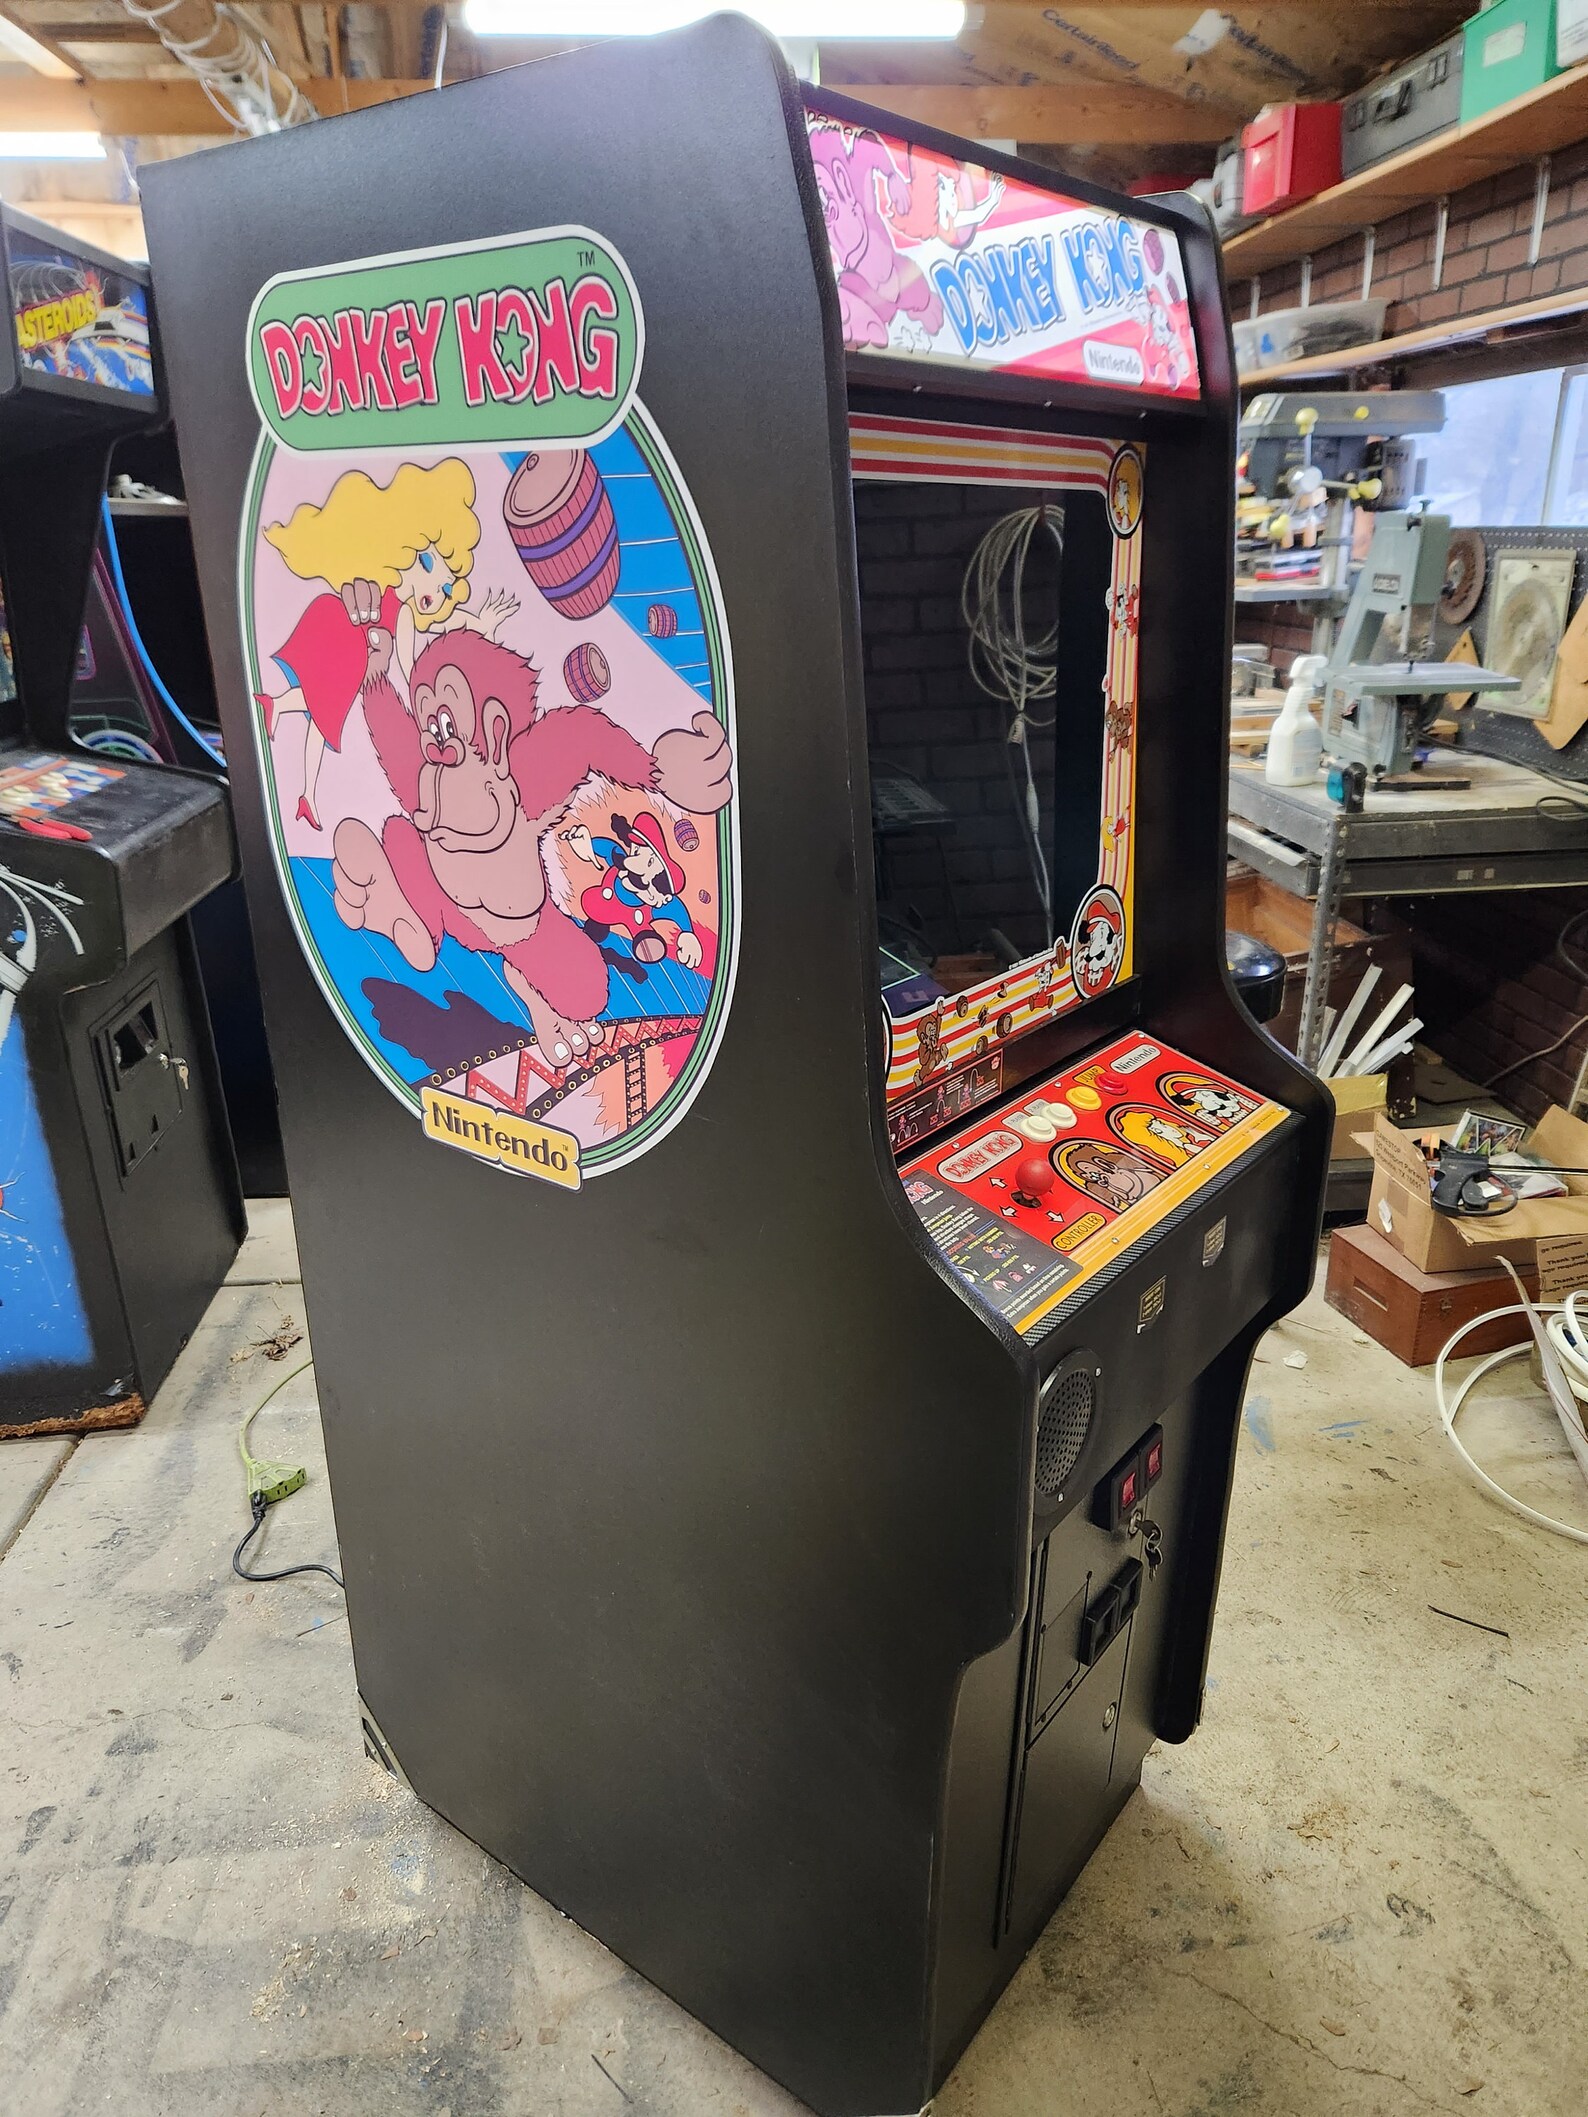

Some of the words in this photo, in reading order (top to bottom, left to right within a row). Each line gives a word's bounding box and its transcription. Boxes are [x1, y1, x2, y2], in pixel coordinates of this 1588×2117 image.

[577, 251, 596, 267] TM
[930, 234, 1066, 357] DONKEY
[1060, 215, 1146, 315] KONG
[259, 299, 447, 420] DONKEY
[454, 272, 619, 407] KONG
[1088, 349, 1141, 375] Nintendo
[1114, 1047, 1157, 1072] Nintendo
[1079, 1068, 1100, 1084] JUMP
[432, 1101, 568, 1172] Nintendo
[946, 1149, 988, 1178] DONKEY
[986, 1135, 1016, 1159] KONG
[1055, 1215, 1103, 1249] CONTROLLER
[1547, 1257, 1570, 1265] Thank
[1570, 1254, 1586, 1262] you
[1552, 1277, 1575, 1285] Thank
